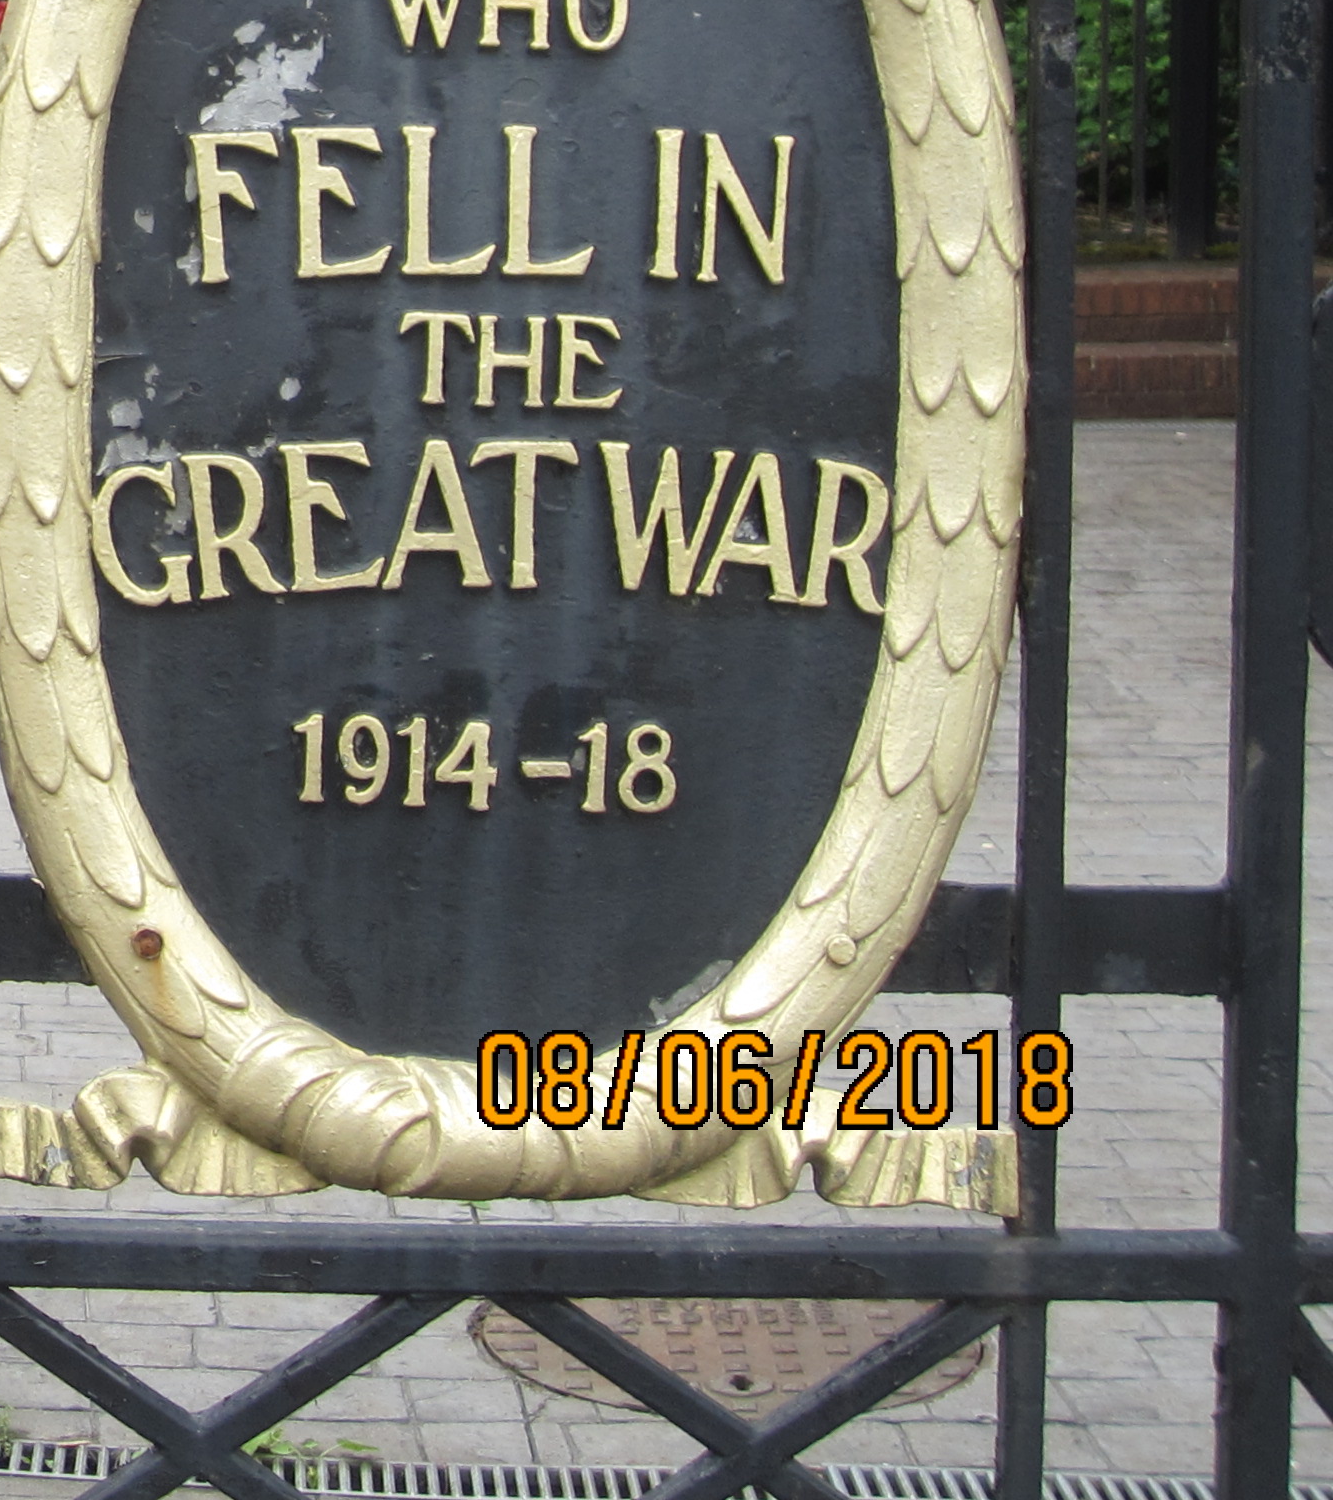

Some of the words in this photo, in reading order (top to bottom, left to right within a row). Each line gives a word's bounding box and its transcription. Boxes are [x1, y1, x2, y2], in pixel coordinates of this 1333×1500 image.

[189, 125, 595, 285] FELL
[649, 128, 796, 285] IN
[399, 311, 623, 409] THE
[93, 439, 578, 606] GREAT
[601, 442, 891, 615] WAR
